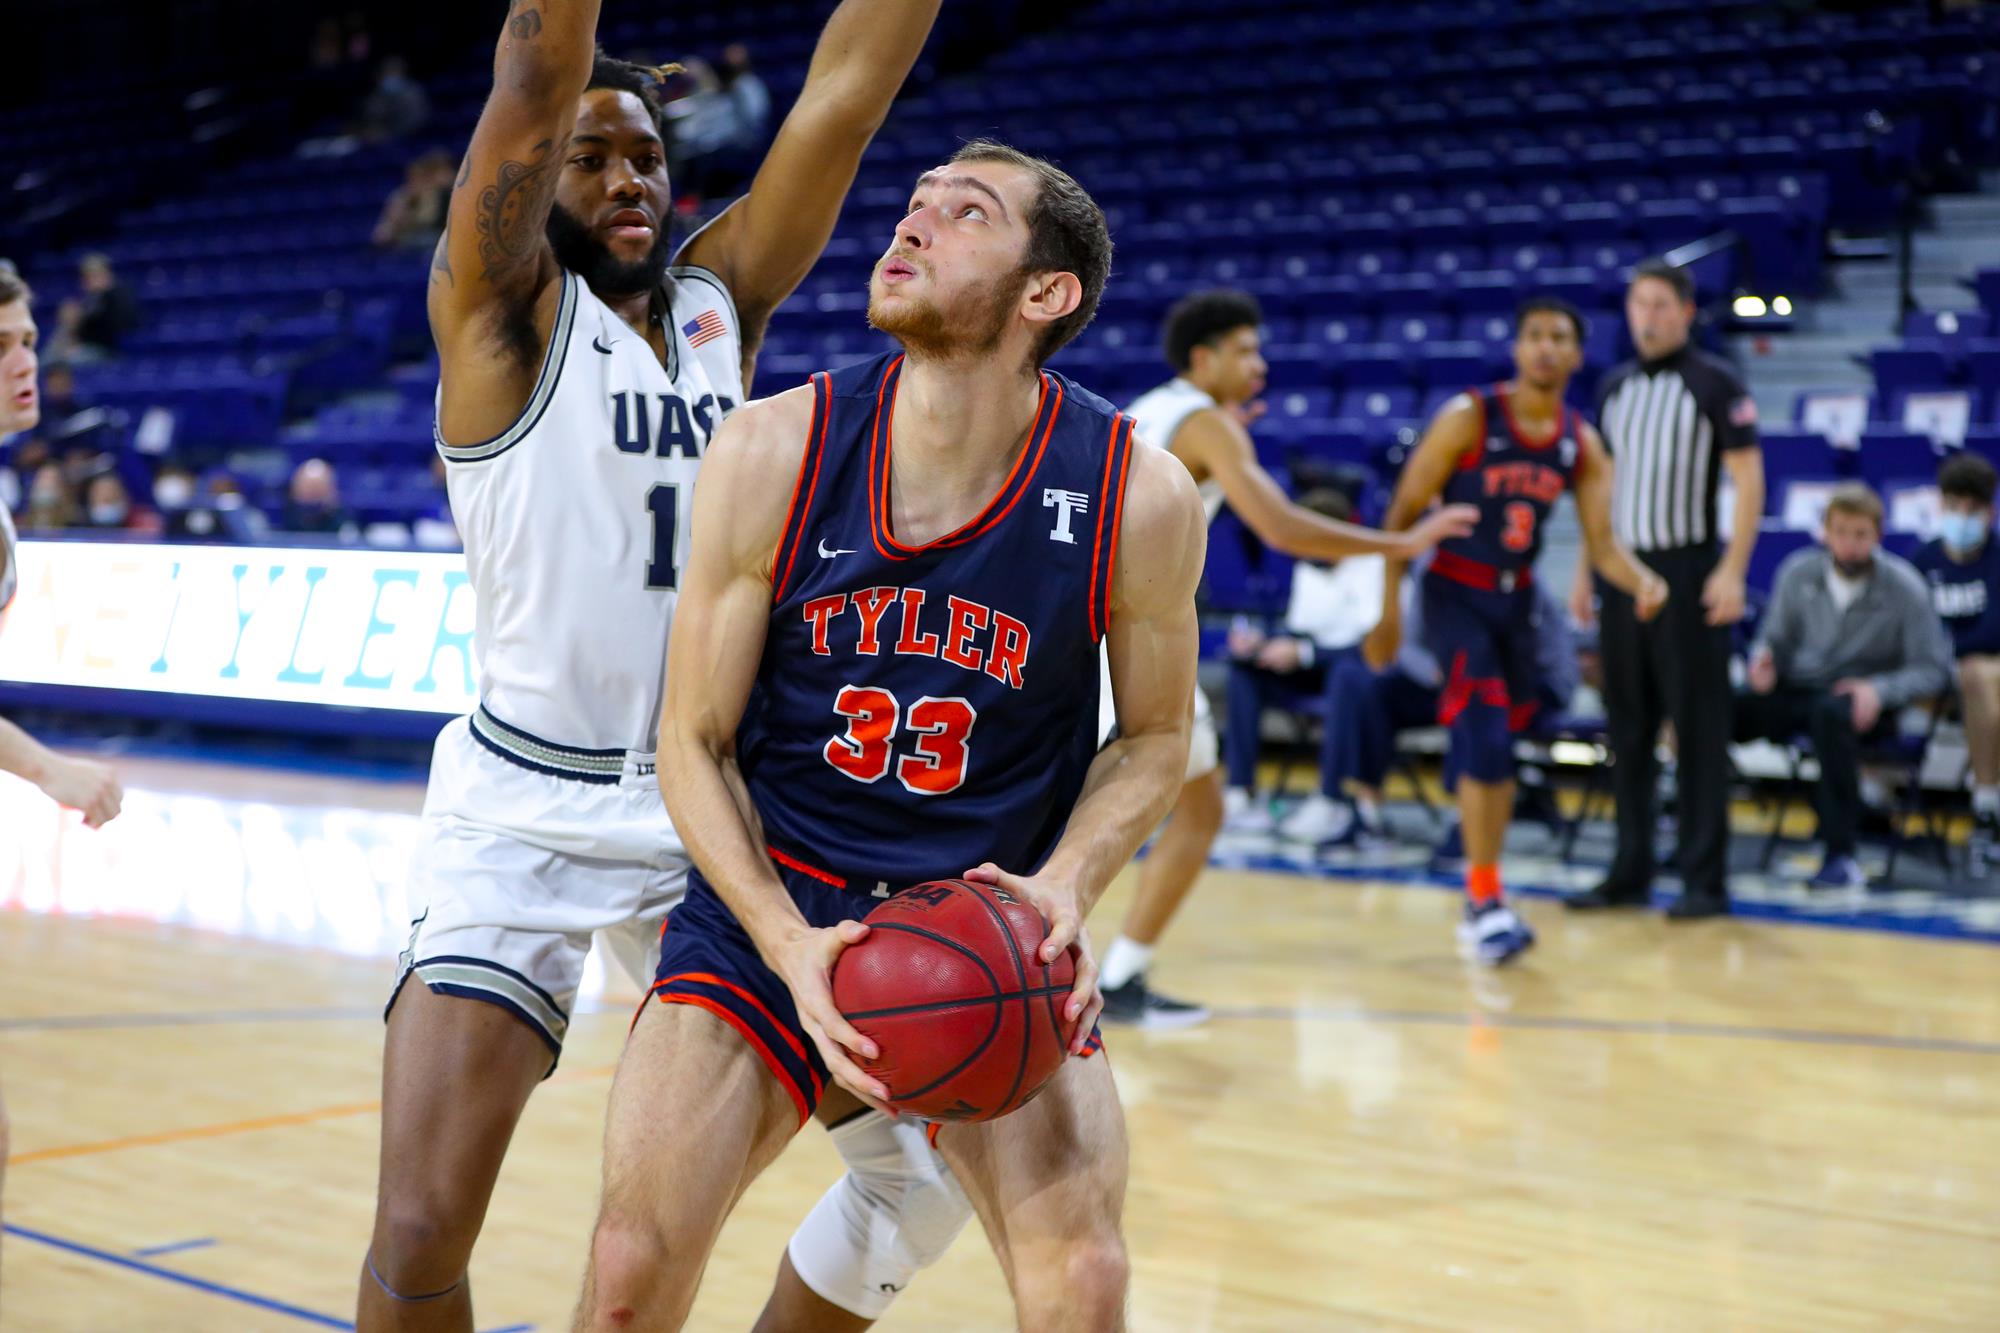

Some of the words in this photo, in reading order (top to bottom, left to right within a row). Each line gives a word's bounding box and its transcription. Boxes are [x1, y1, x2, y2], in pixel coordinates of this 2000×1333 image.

[643, 480, 694, 593] 1
[1500, 501, 1536, 553] 3
[802, 585, 1031, 690] TYLER
[822, 683, 978, 796] 33
